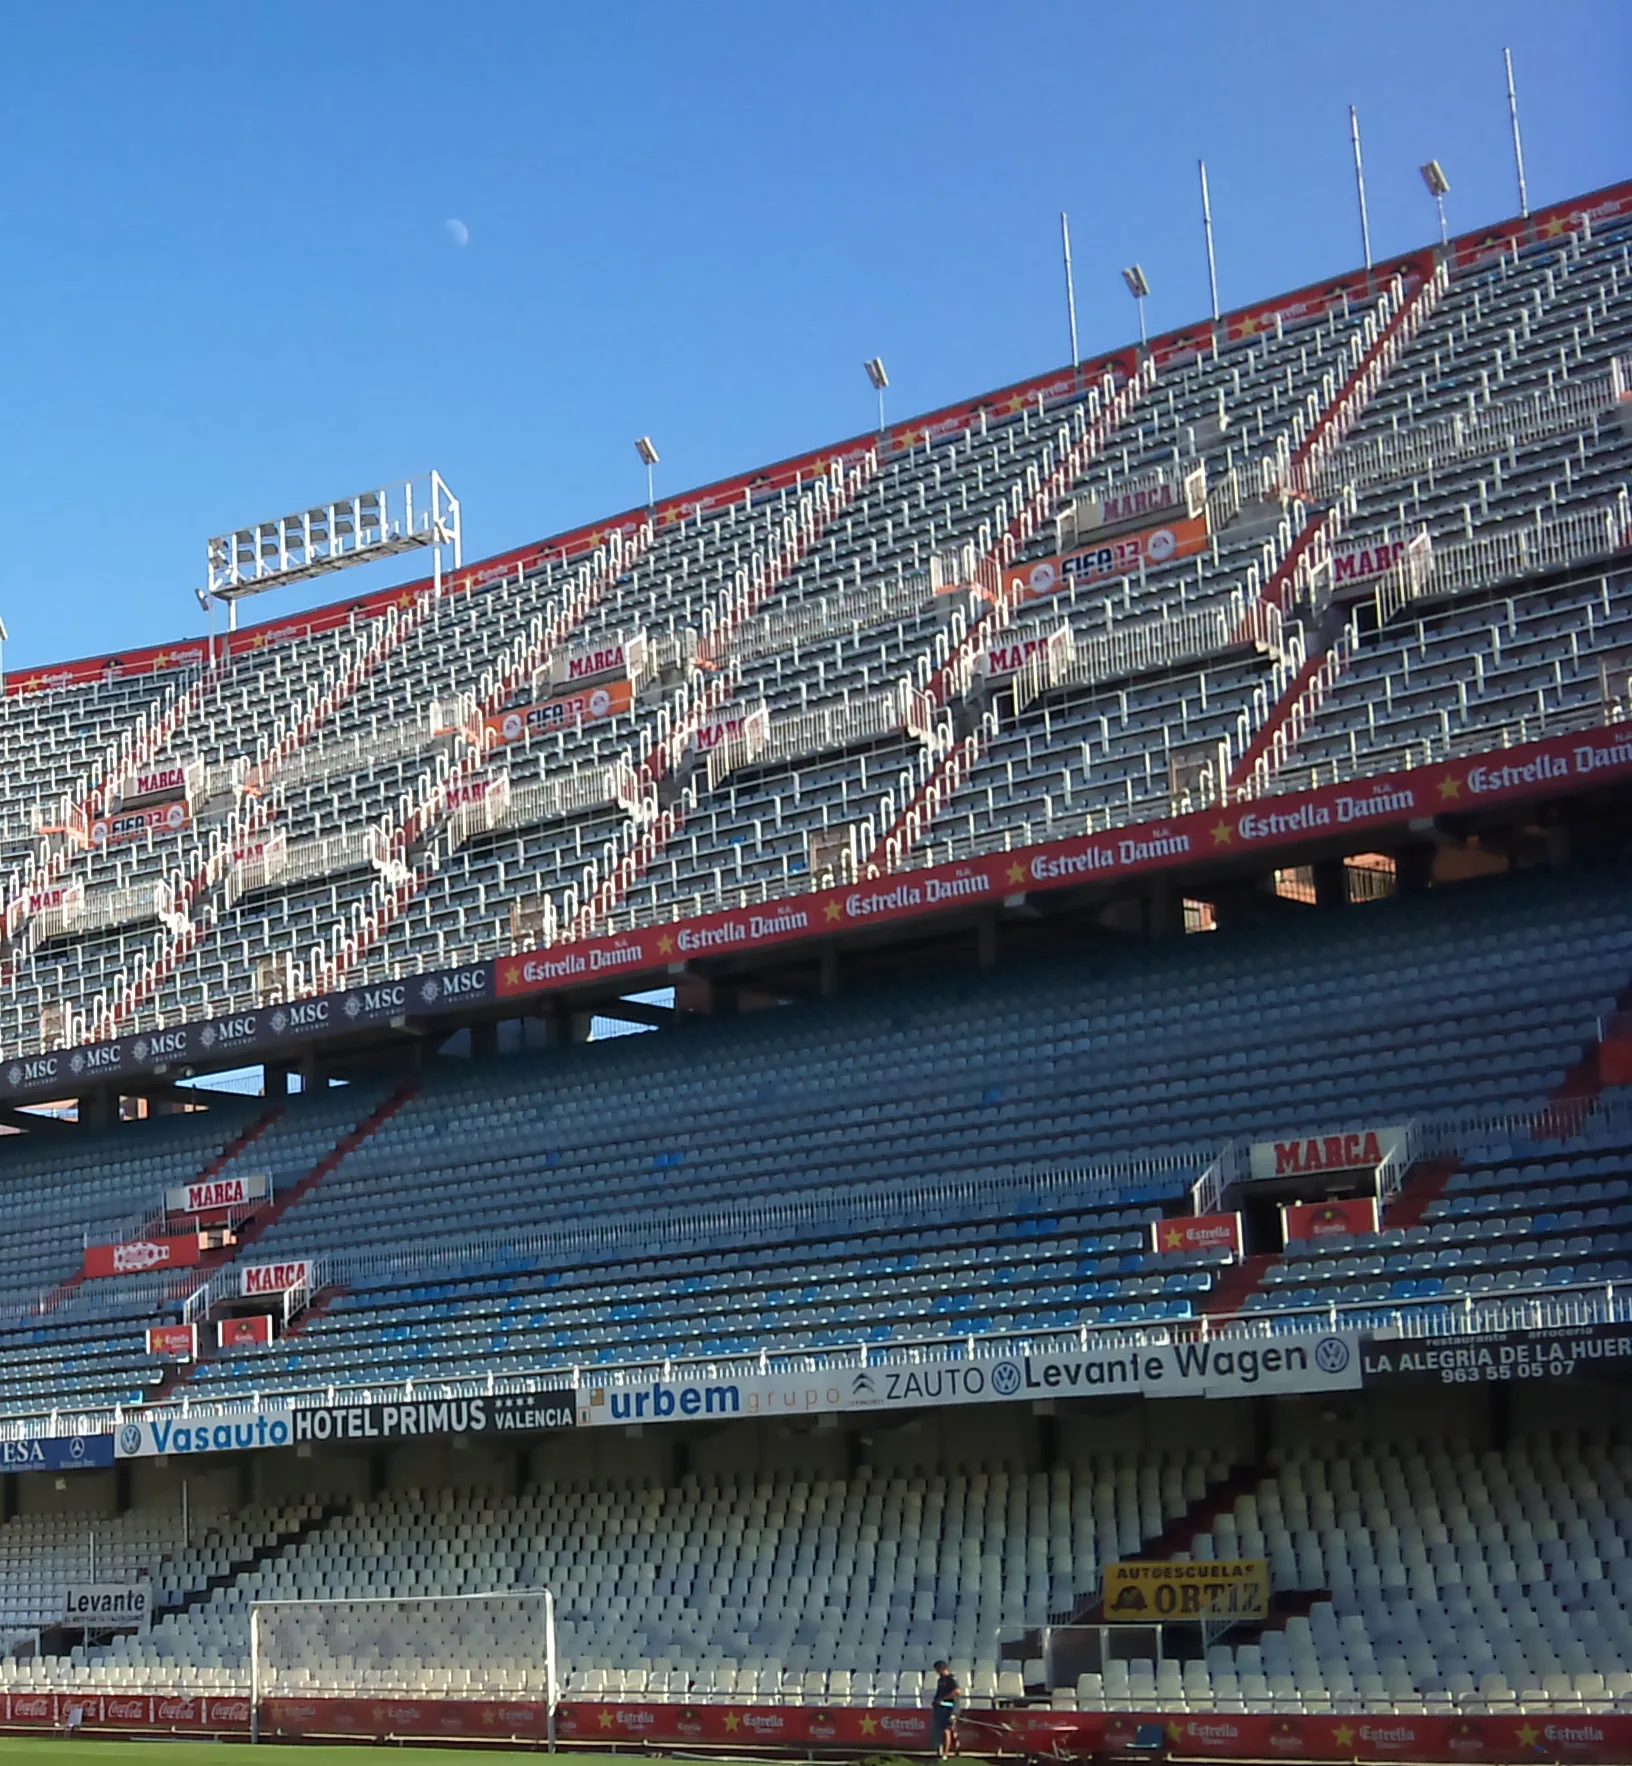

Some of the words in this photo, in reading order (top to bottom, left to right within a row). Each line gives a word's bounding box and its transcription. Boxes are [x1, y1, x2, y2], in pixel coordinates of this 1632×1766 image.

[1103, 485, 1173, 521] MARCA
[1061, 547, 1113, 583] FIFA
[1334, 541, 1405, 582] MARC
[569, 646, 625, 678] MARCA
[989, 637, 1050, 674] MARC
[526, 703, 564, 729] FIFA
[137, 767, 186, 793] MARCA
[1468, 754, 1568, 793] Estrella
[112, 814, 145, 838] FIFA
[1238, 802, 1332, 840] Estrella
[1336, 789, 1415, 823] Damm
[1031, 847, 1114, 880] Estrella
[1119, 834, 1191, 866] Damm
[846, 885, 921, 917] Estrella
[925, 872, 990, 902] Damm
[677, 921, 747, 951] Estrella
[750, 911, 808, 939] Damm
[523, 955, 586, 983] Estrella
[590, 945, 643, 970] Damm
[441, 969, 486, 996] MSC
[364, 986, 405, 1011] MSC
[290, 1001, 329, 1025] MSC
[219, 1016, 257, 1041] MSC
[87, 1045, 121, 1067] MSC
[150, 1032, 187, 1056] MSC
[24, 1058, 58, 1080] MSC
[1274, 1132, 1382, 1175] MARCA
[189, 1180, 244, 1209] MARCA
[1186, 1226, 1231, 1241] Estrella
[246, 1262, 306, 1292] MARCA
[1426, 1332, 1508, 1346] restaurante
[1025, 1352, 1164, 1388] Levante
[1174, 1342, 1308, 1383] Wagen
[1364, 1355, 1397, 1374] LA
[1399, 1345, 1494, 1371] ALEGRÍA
[1500, 1345, 1529, 1364] DE
[1535, 1342, 1565, 1362] LA
[1441, 1365, 1479, 1383] 963
[1486, 1364, 1511, 1380] 55
[1517, 1362, 1544, 1378] 05
[1550, 1360, 1575, 1376] 07
[885, 1366, 985, 1400] ZAUTO
[610, 1382, 740, 1419] urbem
[747, 1386, 840, 1415] grupo
[296, 1408, 379, 1440] HOTEL
[383, 1399, 486, 1437] PRIMUS
[495, 1407, 574, 1431] VALENCIA
[149, 1415, 289, 1454] Vasauto
[66, 1589, 145, 1612] Levante
[743, 1713, 784, 1728] Estrella
[880, 1716, 926, 1731] Estrella
[1188, 1722, 1238, 1738] Estrella
[1360, 1725, 1415, 1742] Estrella
[1545, 1724, 1604, 1743] Estrella
